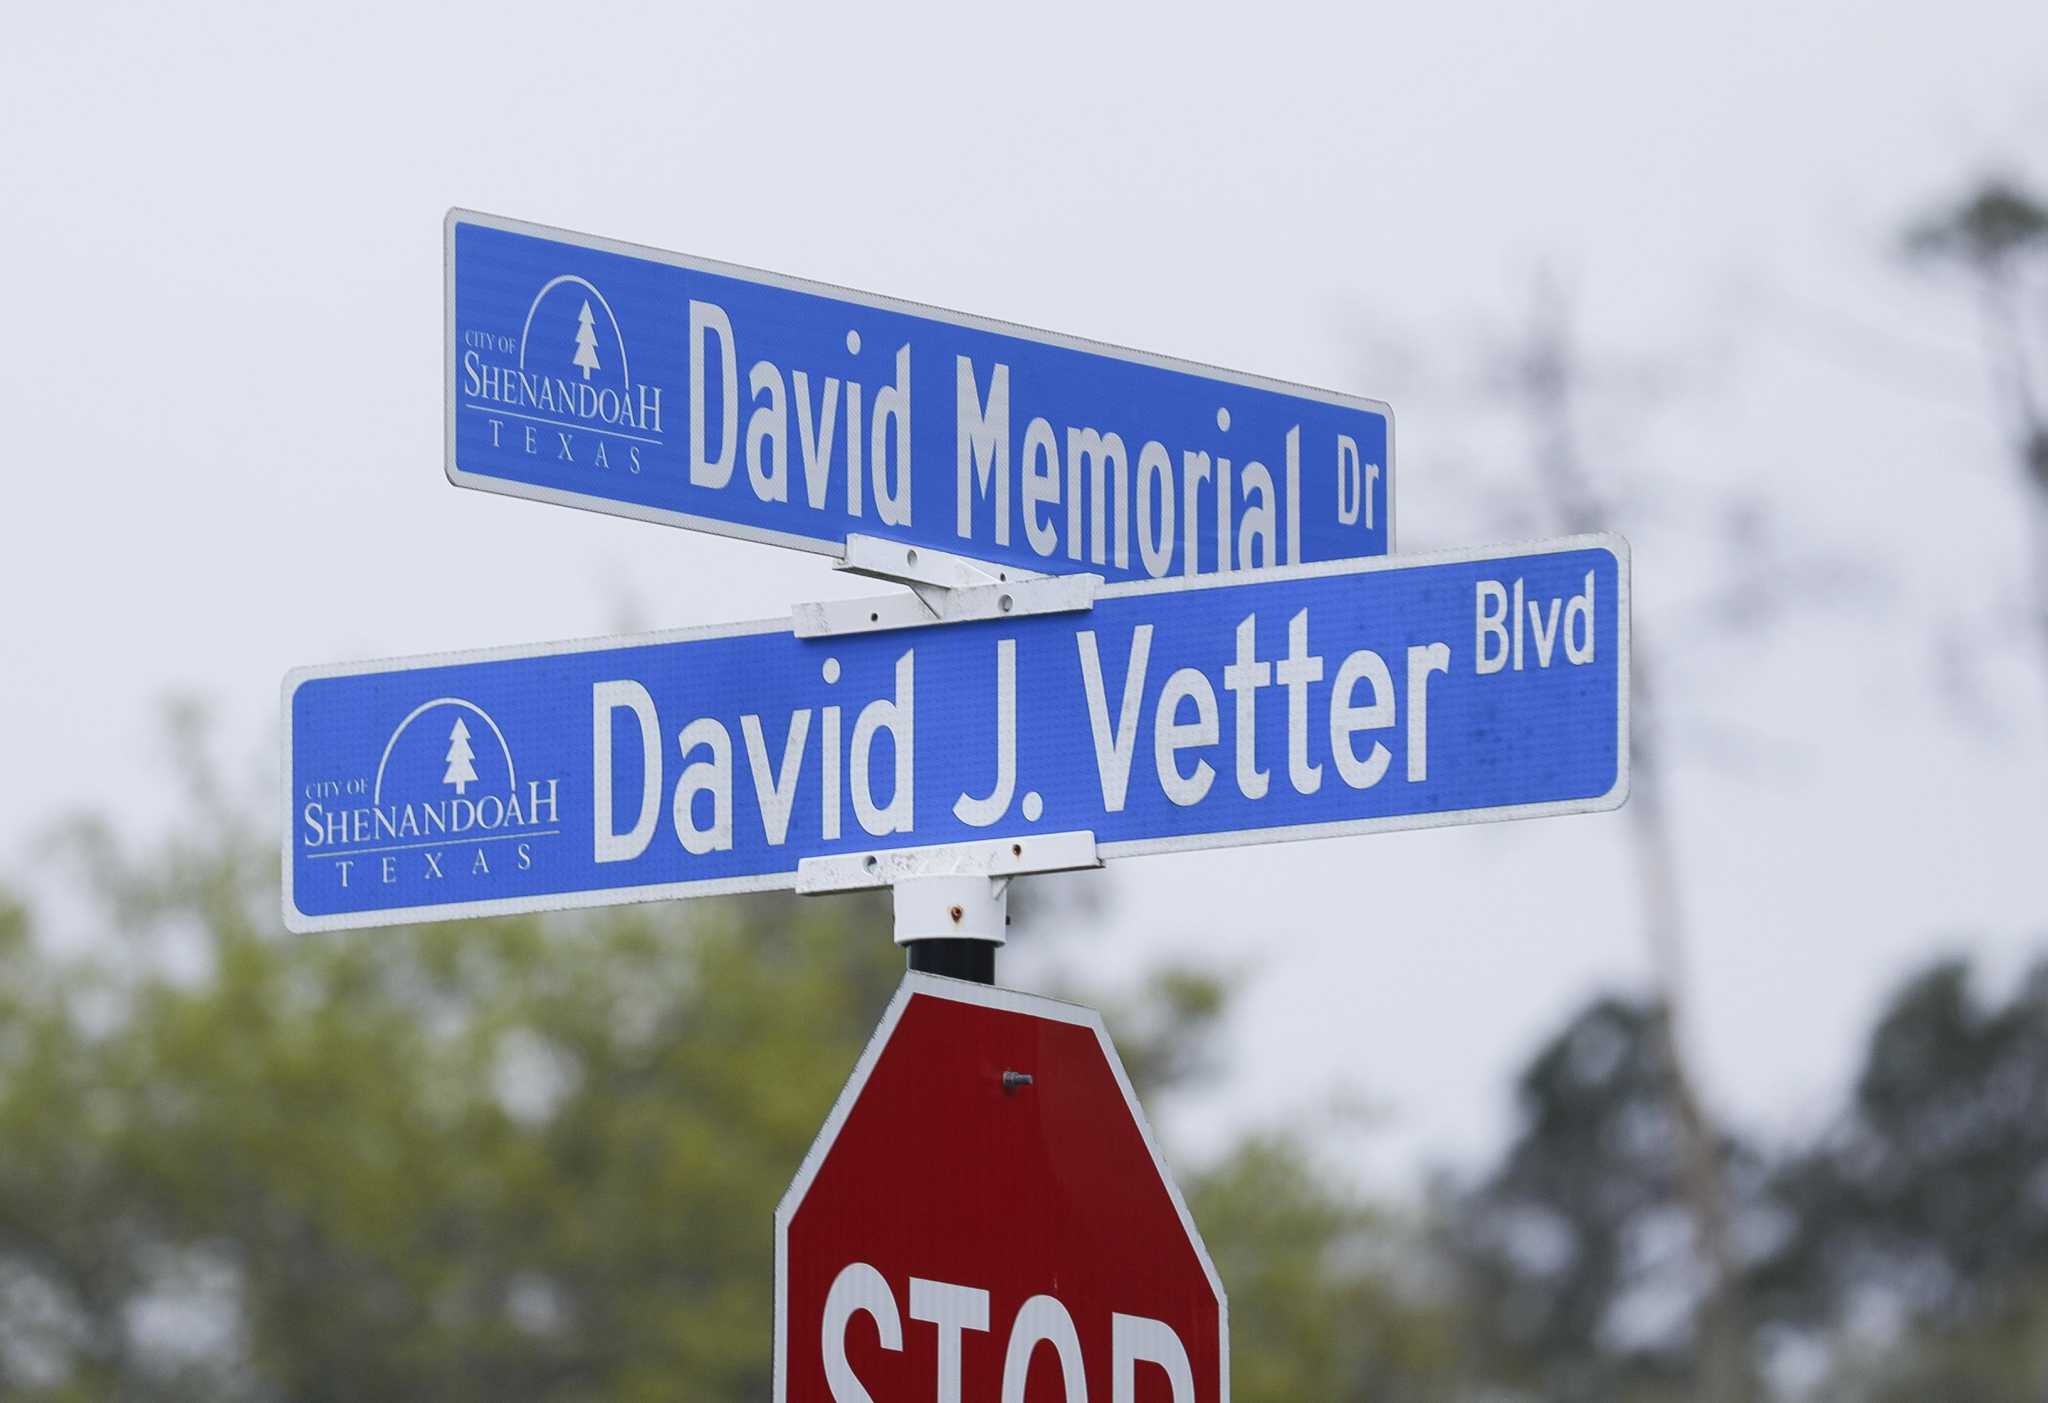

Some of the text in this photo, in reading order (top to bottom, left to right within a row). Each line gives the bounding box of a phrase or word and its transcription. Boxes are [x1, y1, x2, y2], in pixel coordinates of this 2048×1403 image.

[464, 330, 516, 354] CITY OF
[464, 351, 663, 433] SHENANDOAH
[689, 299, 1379, 578] David Memorial Dr
[593, 569, 1596, 864] David J. Vetter Blvd
[303, 778, 560, 848] SHENANDOAH
[305, 778, 369, 801] CITY OF
